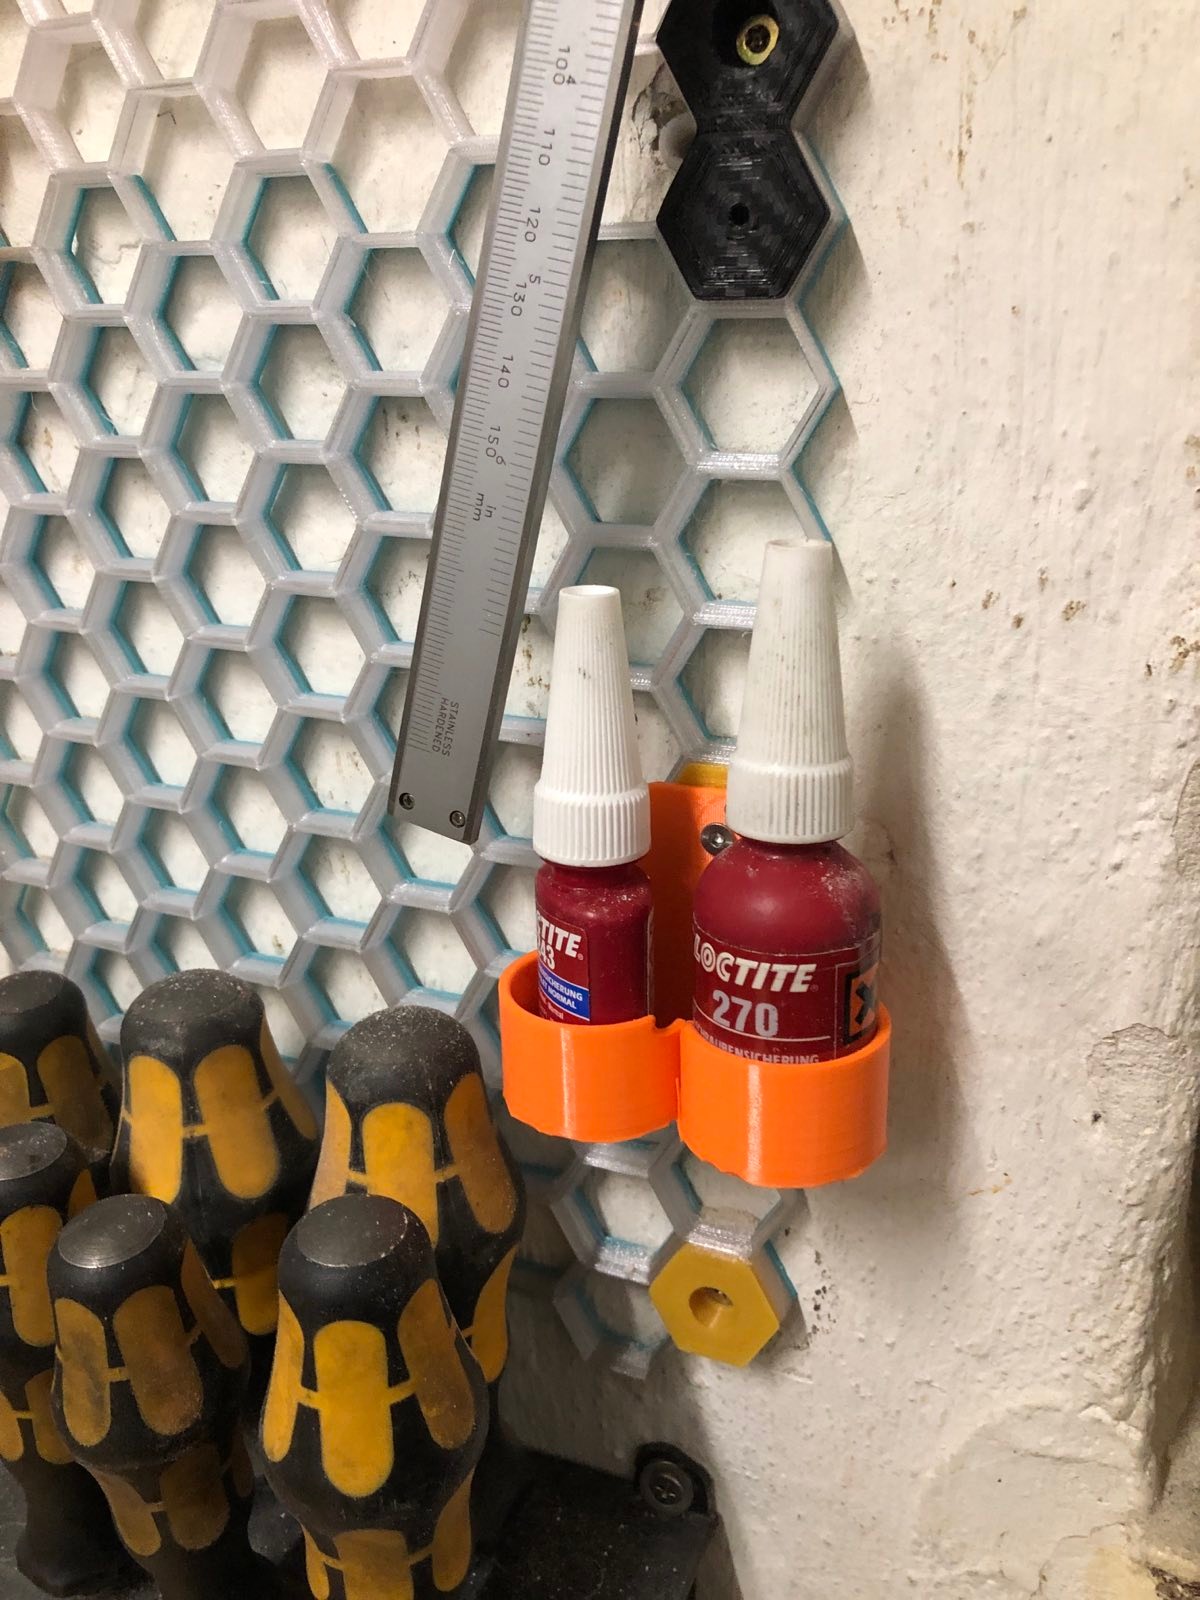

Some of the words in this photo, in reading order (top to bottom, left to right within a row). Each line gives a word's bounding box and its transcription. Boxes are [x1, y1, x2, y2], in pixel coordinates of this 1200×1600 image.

[553, 46, 571, 85] 100
[566, 75, 577, 85] 4
[538, 128, 555, 166] 110
[524, 207, 541, 243] 120
[528, 273, 541, 285] 5
[511, 282, 527, 317] 130
[497, 355, 514, 389] 140
[485, 425, 501, 458] 150
[495, 455, 507, 466] 6
[472, 492, 485, 522] mm
[484, 505, 497, 519] in
[431, 697, 450, 753] HARDENED
[441, 700, 460, 757] STAINLESS
[693, 933, 817, 993] LOCTITE
[712, 990, 780, 1038] 270
